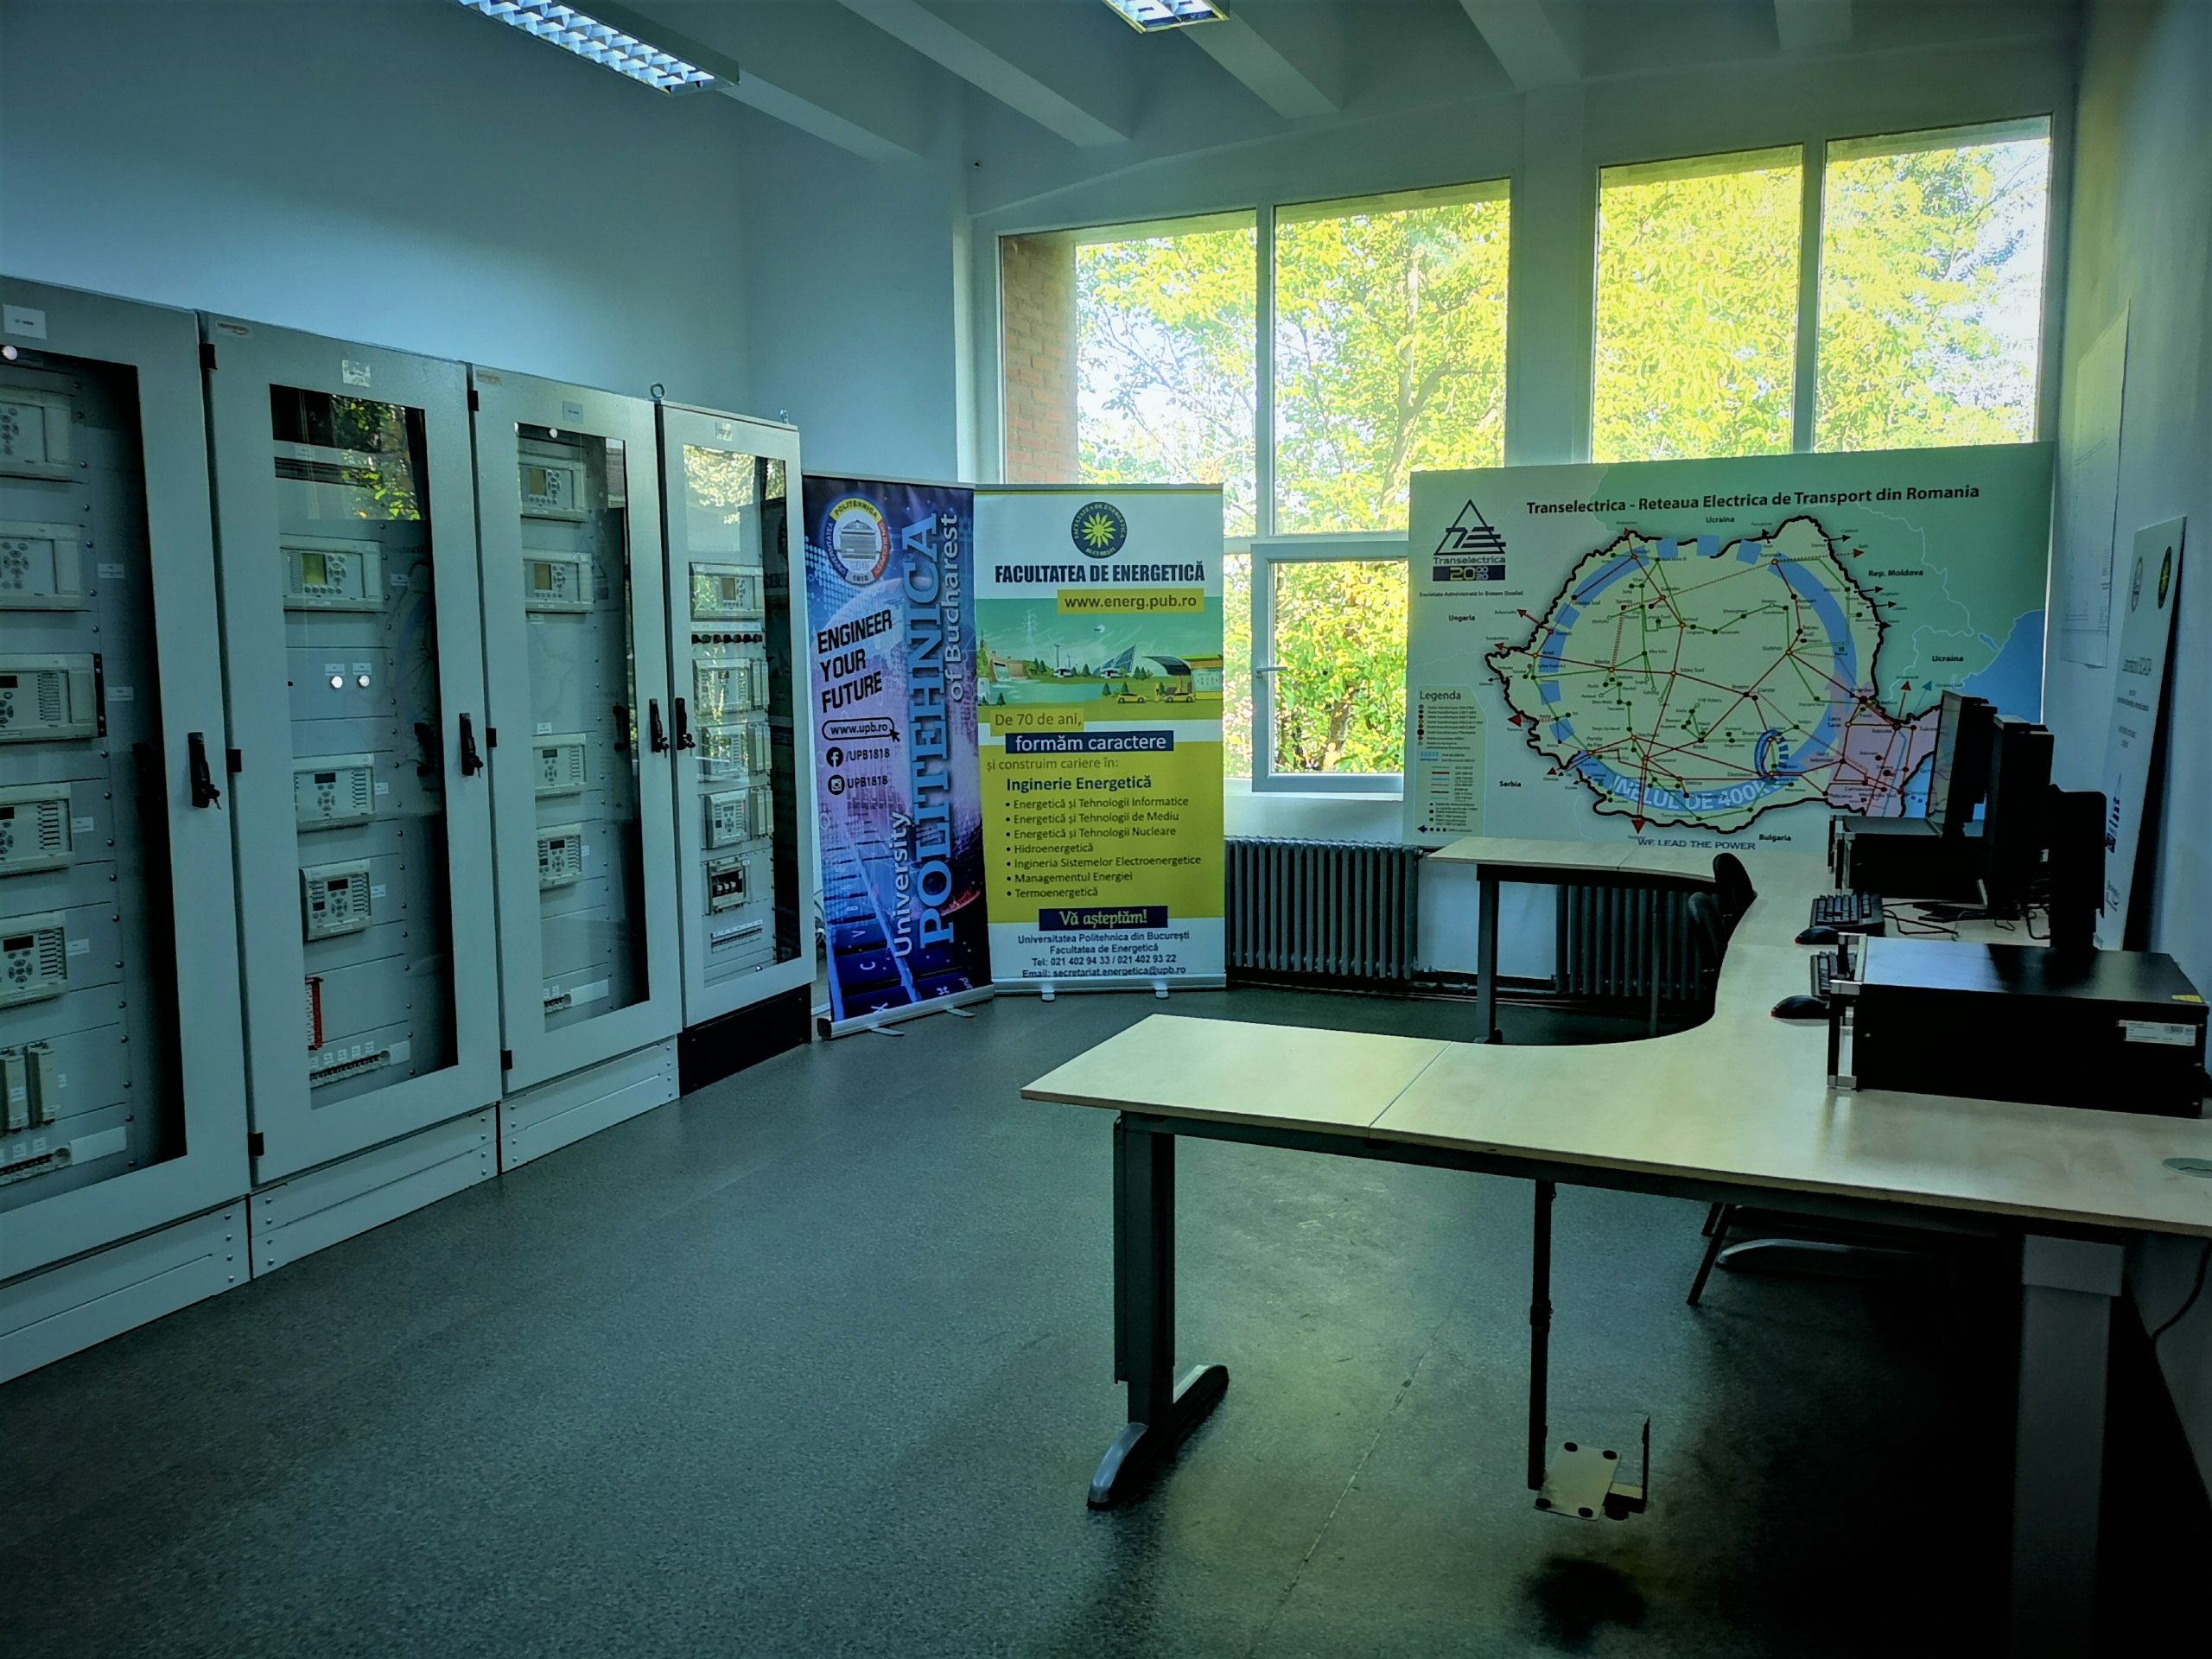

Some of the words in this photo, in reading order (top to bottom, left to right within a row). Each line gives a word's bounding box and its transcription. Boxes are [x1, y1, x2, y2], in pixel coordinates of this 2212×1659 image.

[1526, 499, 1626, 515] Transelectrica
[1638, 497, 1699, 511] Reteaua
[1703, 494, 1768, 508] Electrica
[1771, 492, 1791, 506] de
[1794, 490, 1872, 506] Transport
[1876, 487, 1902, 501] din
[1906, 484, 1980, 500] Romania
[995, 564, 1087, 584] FACULTATEA
[1090, 564, 1110, 583] DE
[1112, 559, 1205, 582] ENERGETICĂ
[940, 513, 963, 664] Bucharest
[1065, 594, 1197, 611] www.energ.pub.ro
[817, 608, 893, 655] ENGINEER
[820, 648, 867, 683] YOUR
[822, 671, 883, 714] FUTURE
[945, 669, 963, 701] of
[1419, 690, 1461, 702] Legenda
[995, 714, 1013, 726] De
[1017, 713, 1033, 726] 70
[1037, 713, 1054, 725] de
[1058, 713, 1082, 727] ani,
[830, 721, 888, 736] www.upb.ro
[902, 512, 954, 950] POLITEHNICA
[1015, 734, 1084, 752] formăm
[1088, 734, 1166, 751] caractere
[845, 747, 890, 761] /UPB1818
[987, 760, 995, 772] și
[999, 759, 1058, 770] construim
[1060, 758, 1101, 769] cariere
[1103, 757, 1118, 768] în:
[847, 775, 888, 789] UPB1818
[1007, 778, 1072, 793] Inginerie
[1076, 775, 1152, 791] Energetică
[1014, 798, 1065, 810] Energetică
[1069, 799, 1076, 810] și
[1079, 798, 1129, 810] Tehnologii
[1132, 797, 1189, 806] Informatice
[1687, 792, 1714, 810] DE
[1014, 814, 1066, 825] Energetică
[1069, 815, 1077, 824] și
[1079, 812, 1129, 824] Tehnologii
[1132, 811, 1145, 822] de
[1147, 810, 1179, 822] Mediu
[1014, 829, 1066, 840] Energetică
[1069, 830, 1077, 839] și
[1079, 827, 1129, 839] Tehnologii
[1132, 826, 1176, 836] Nucleare
[1759, 834, 1792, 842] Bulgaria
[1014, 842, 1094, 855] Hidroenergetică
[1637, 838, 1655, 847] WE
[1657, 839, 1687, 848] LEAD
[1689, 840, 1712, 849] THE
[1714, 841, 1756, 850] POWER
[1014, 859, 1058, 870] Ingineria
[1060, 857, 1113, 868] Sistemelor
[1116, 855, 1202, 868] Electroenergetice
[890, 811, 916, 959] University
[1015, 872, 1090, 885] Managementul
[1093, 871, 1133, 883] Energiei
[1015, 887, 1098, 899] Termoenergetică
[1059, 910, 1078, 926] Vă
[1083, 909, 1147, 929] așteptăm!
[1018, 934, 1077, 944] Universitatea
[1078, 933, 1128, 943] Politehnica
[1130, 931, 1145, 941] din
[1147, 931, 1190, 942] București
[1050, 944, 1096, 955] Facultatea
[1098, 944, 1109, 953] de
[1111, 943, 1159, 954] Energetică
[1032, 957, 1048, 966] Tel:
[1051, 957, 1065, 966] 021
[1068, 957, 1084, 965] 402
[1086, 956, 1097, 964] 94
[1099, 956, 1110, 964] 33
[1117, 955, 1133, 964] 021
[1135, 954, 1151, 963] 402
[1153, 954, 1163, 963] 93
[1166, 954, 1177, 963] 22
[1022, 969, 1051, 978] Email:
